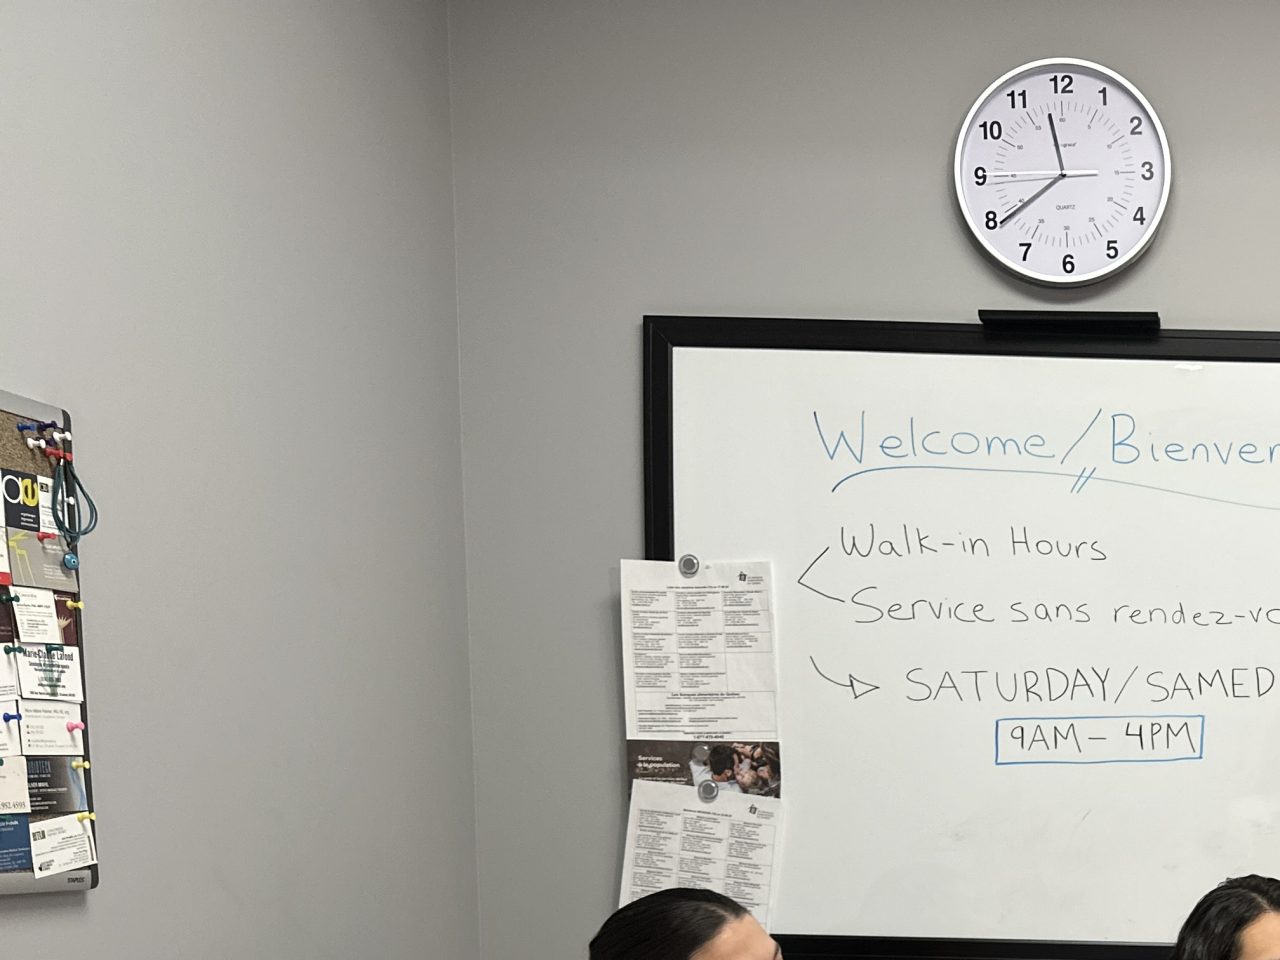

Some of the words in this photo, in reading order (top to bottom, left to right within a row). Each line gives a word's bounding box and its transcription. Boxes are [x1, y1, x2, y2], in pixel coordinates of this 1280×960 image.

[1049, 74, 1074, 94] 12
[1006, 90, 1027, 109] 11
[1098, 87, 1107, 106] 1
[978, 120, 1003, 140] 10
[1129, 116, 1143, 135] 2
[974, 166, 987, 186] 9
[1141, 161, 1154, 181] 3
[985, 211, 998, 230] 8
[1132, 206, 1146, 226] 4
[1018, 243, 1032, 262] 7
[1106, 240, 1119, 259] 5
[1062, 254, 1075, 274] 6
[840, 522, 990, 558] Walk-in
[1010, 526, 1108, 562] Hours
[851, 586, 995, 624] Service
[1010, 600, 1091, 624] sans
[1124, 720, 1197, 754] 4PM
[638, 754, 663, 762] Services
